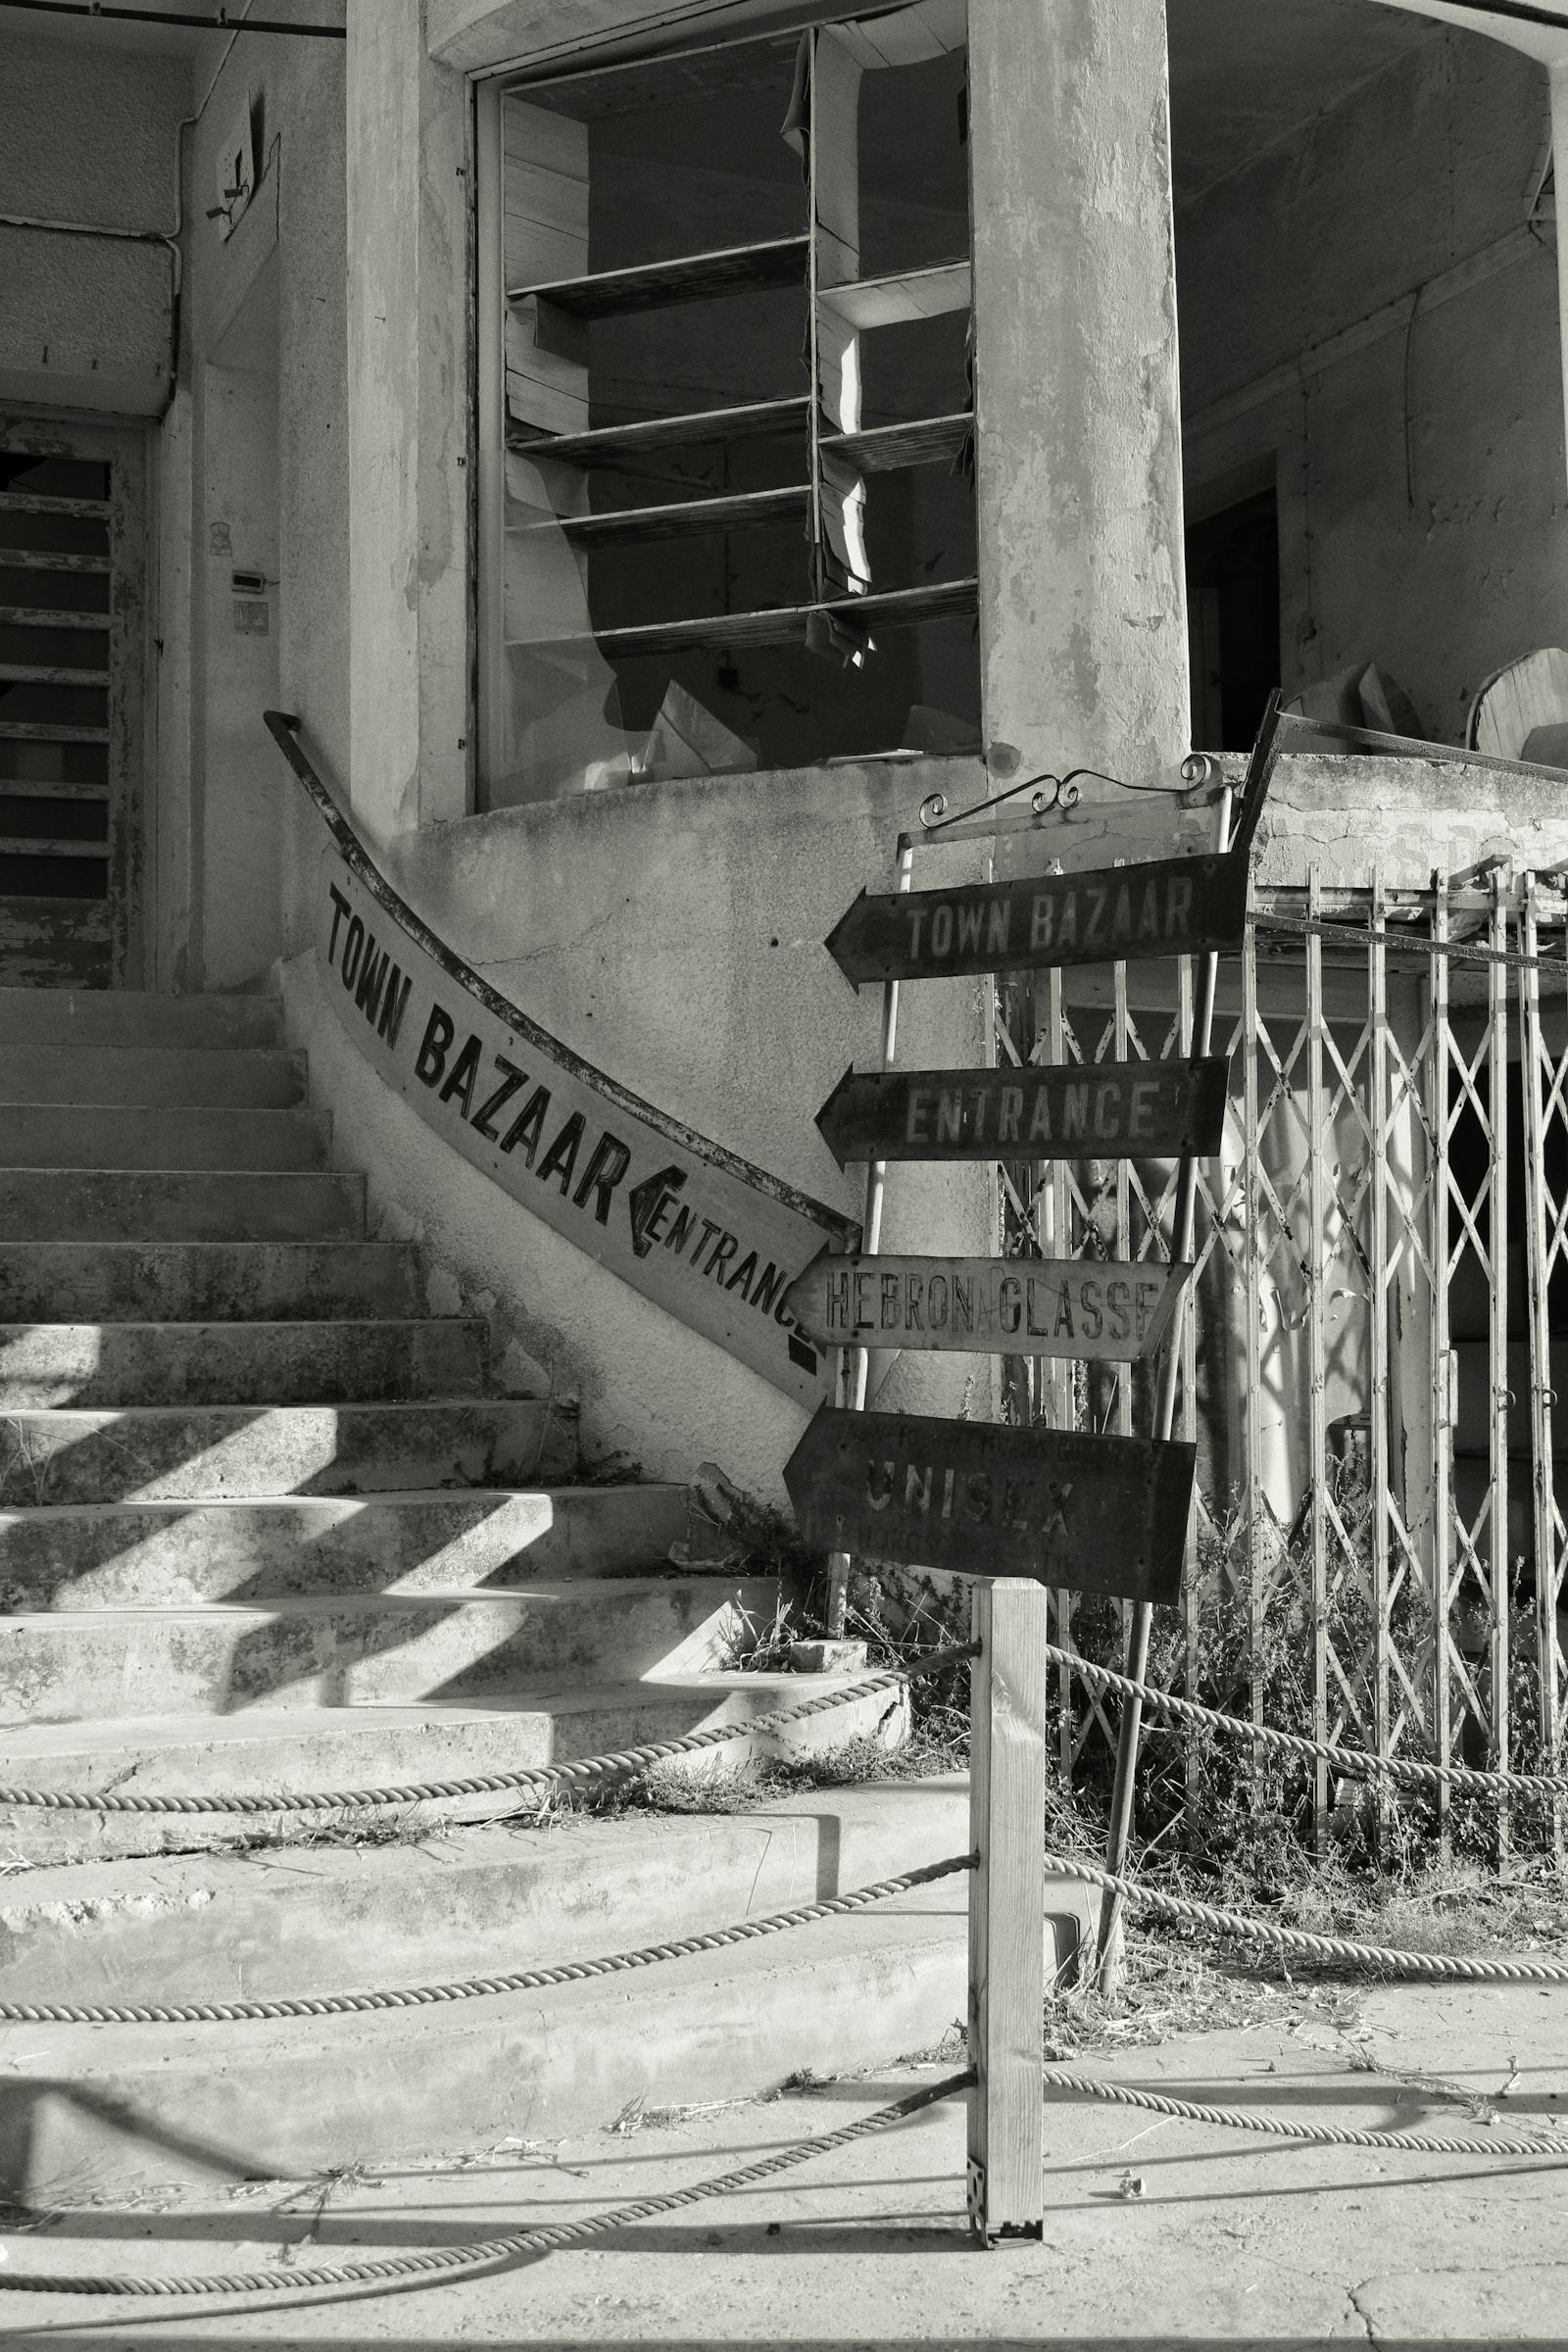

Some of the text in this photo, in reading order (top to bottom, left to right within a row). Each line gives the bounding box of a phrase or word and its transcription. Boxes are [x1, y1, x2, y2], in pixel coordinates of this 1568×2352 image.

[906, 875, 1195, 960] TOWN BAZAAR
[329, 882, 632, 1226] TOWN BAZAAR
[905, 1080, 1160, 1144] ENTRANCE
[643, 1189, 812, 1344] ENTRANC
[826, 1271, 975, 1334] HEBRON
[865, 1459, 1075, 1537] UNISEX
